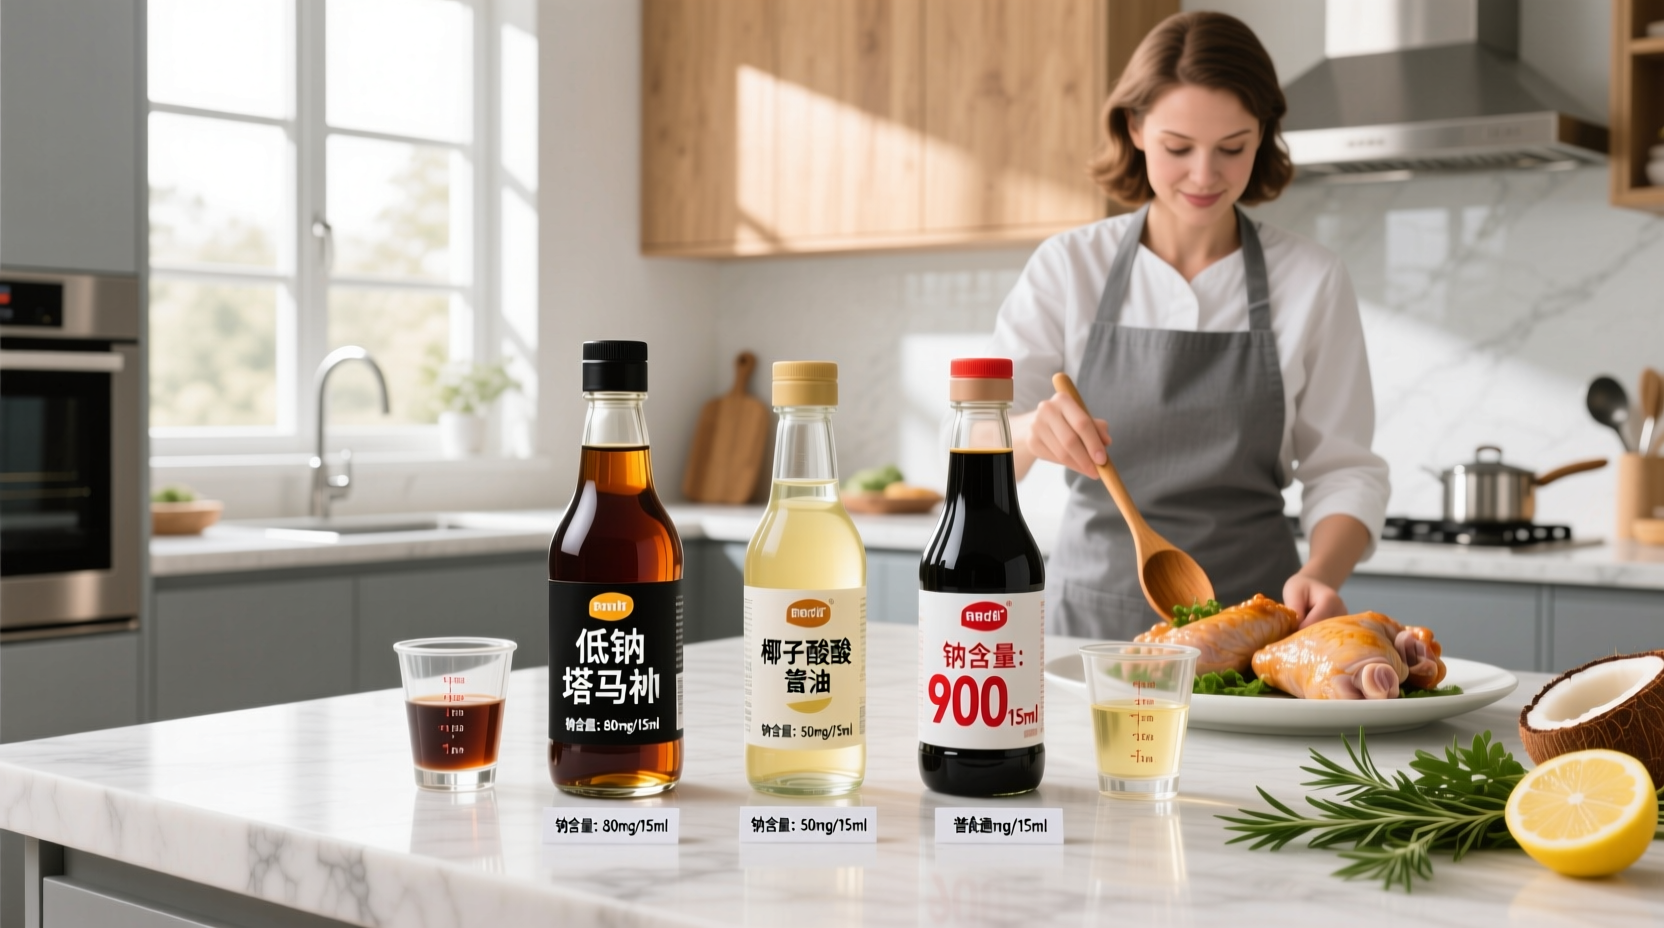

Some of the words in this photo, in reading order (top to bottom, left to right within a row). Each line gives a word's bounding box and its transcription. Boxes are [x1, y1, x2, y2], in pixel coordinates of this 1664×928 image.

[576, 627, 645, 665] 低钠
[943, 640, 1024, 669] 钠含量:
[928, 673, 1008, 728] 900
[1008, 703, 1038, 726] 15ml
[602, 818, 668, 836] 80mg/15ml
